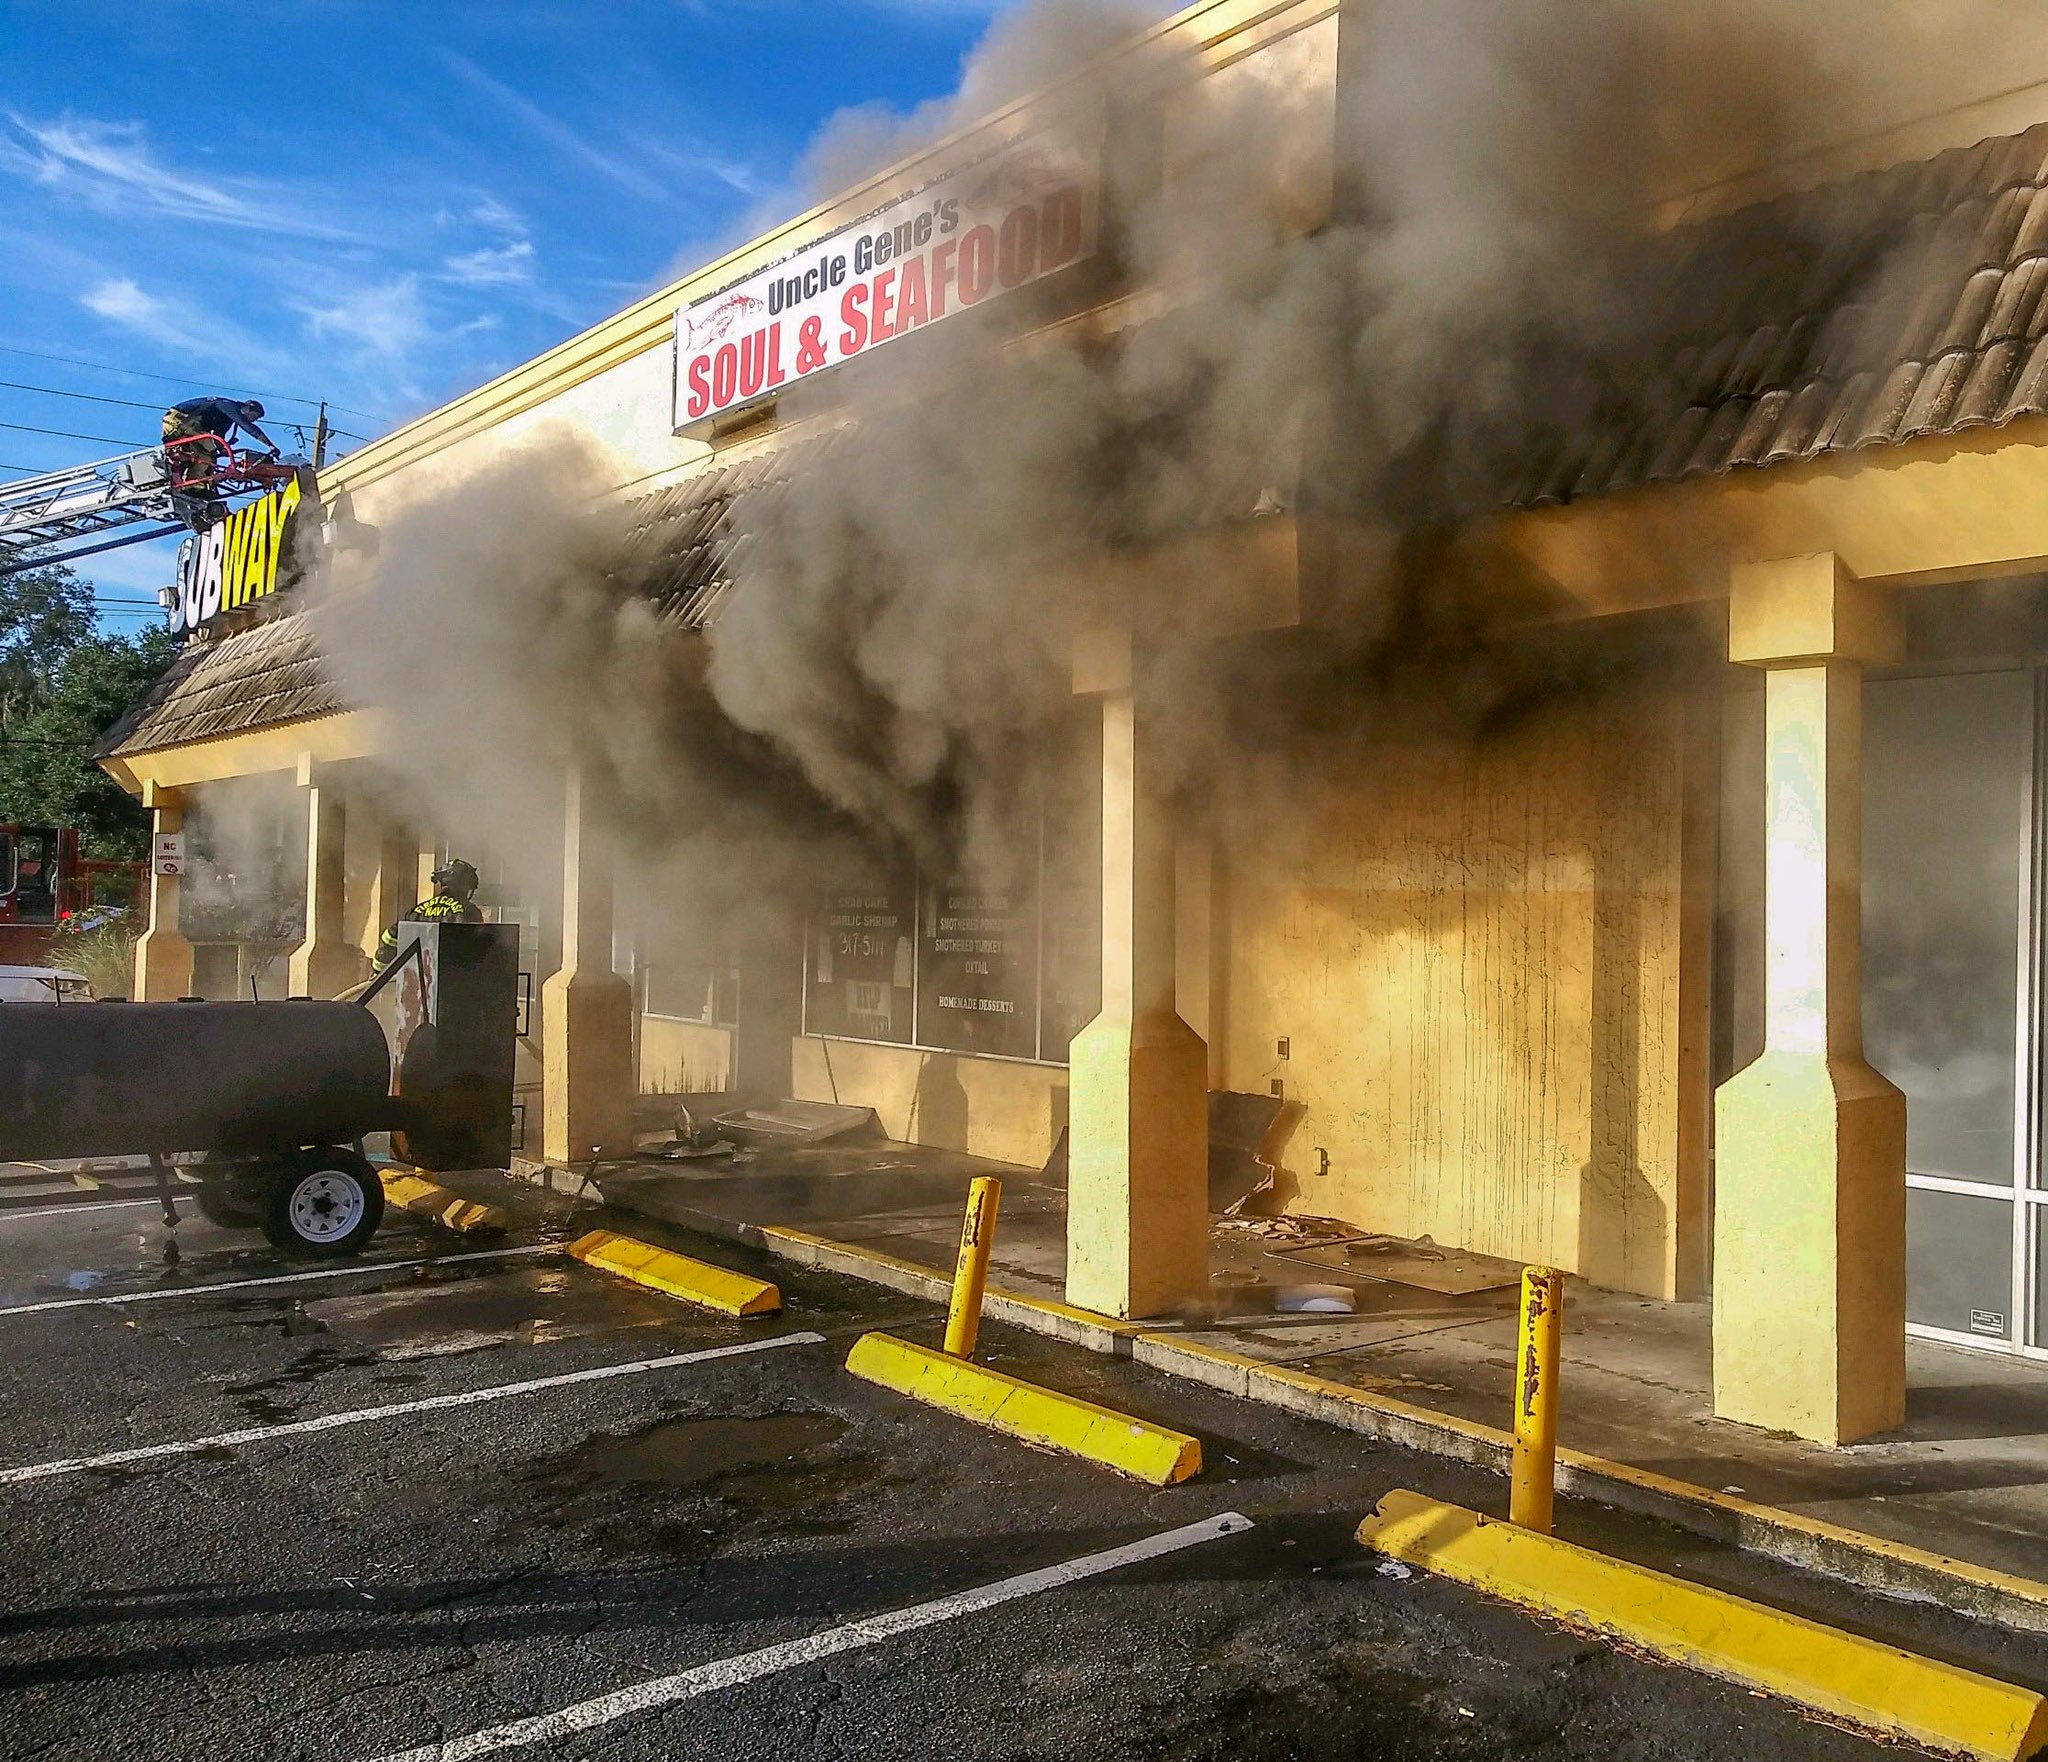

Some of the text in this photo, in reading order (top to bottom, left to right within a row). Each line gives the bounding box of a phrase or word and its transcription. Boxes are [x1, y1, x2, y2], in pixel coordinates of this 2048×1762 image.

[768, 198, 960, 316] Uncle Gene's
[687, 184, 1083, 418] SOUL & SEAFOOD
[169, 470, 301, 633] SUBWAY
[163, 842, 177, 851] NO
[414, 895, 464, 914] FIRST COAST
[425, 906, 450, 917] NAVY
[864, 916, 898, 928] SHRIMP
[939, 996, 1014, 1013] HOMEMADE DESSERTS
